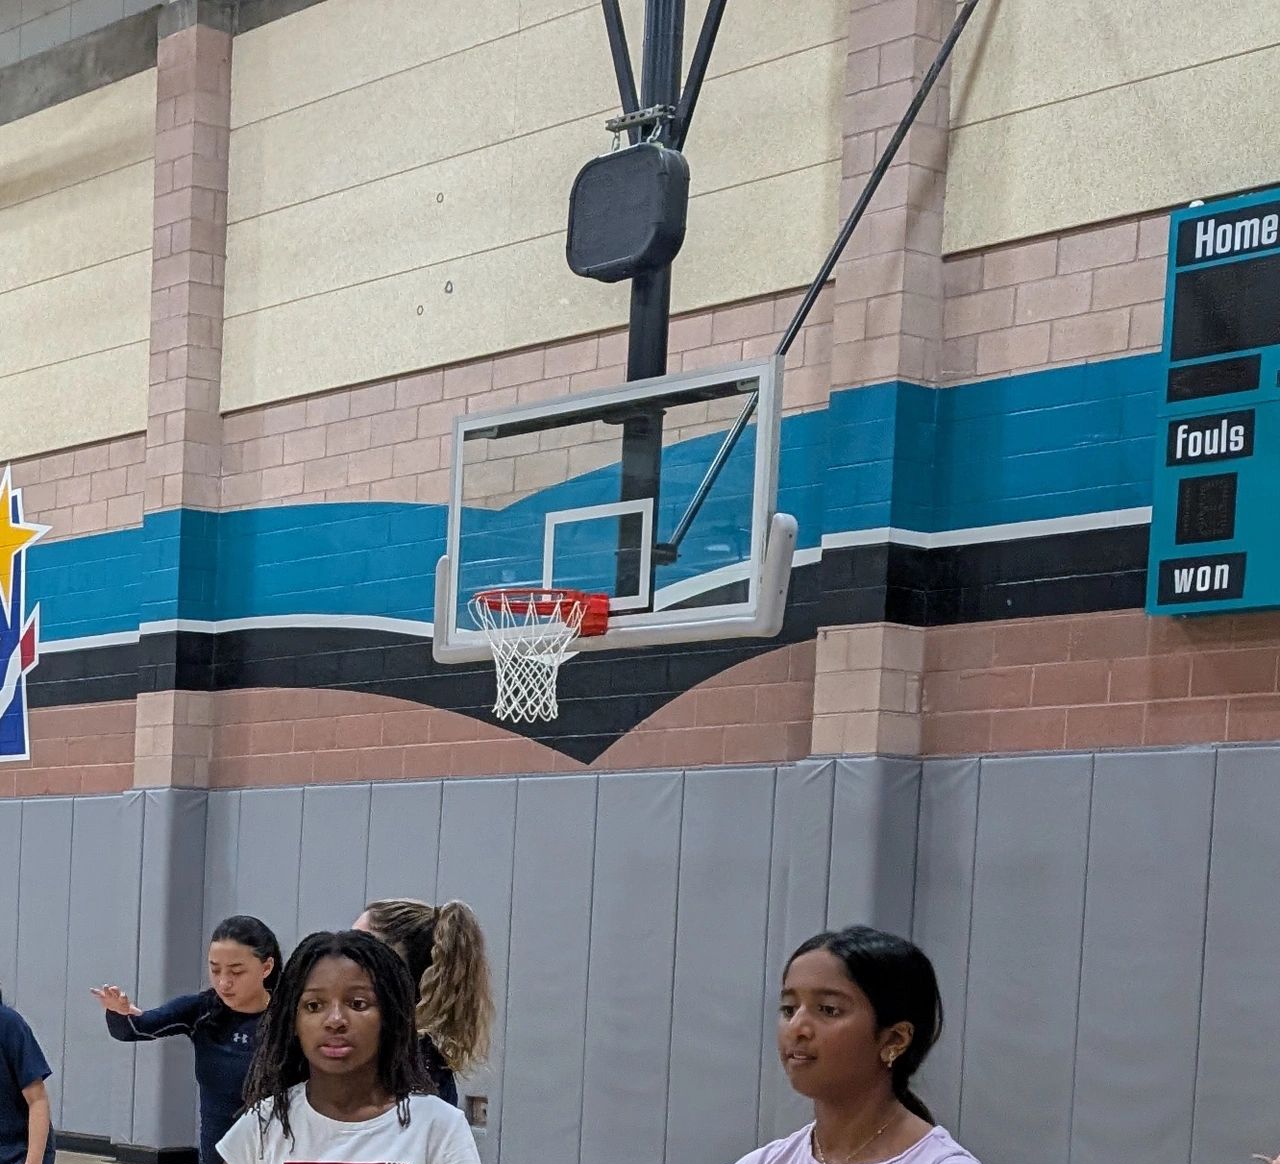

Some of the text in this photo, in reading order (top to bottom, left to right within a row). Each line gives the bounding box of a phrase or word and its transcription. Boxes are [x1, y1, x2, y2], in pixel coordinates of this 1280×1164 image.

[1194, 213, 1279, 259] Home
[1175, 419, 1245, 460] fouls
[1173, 563, 1230, 595] won
